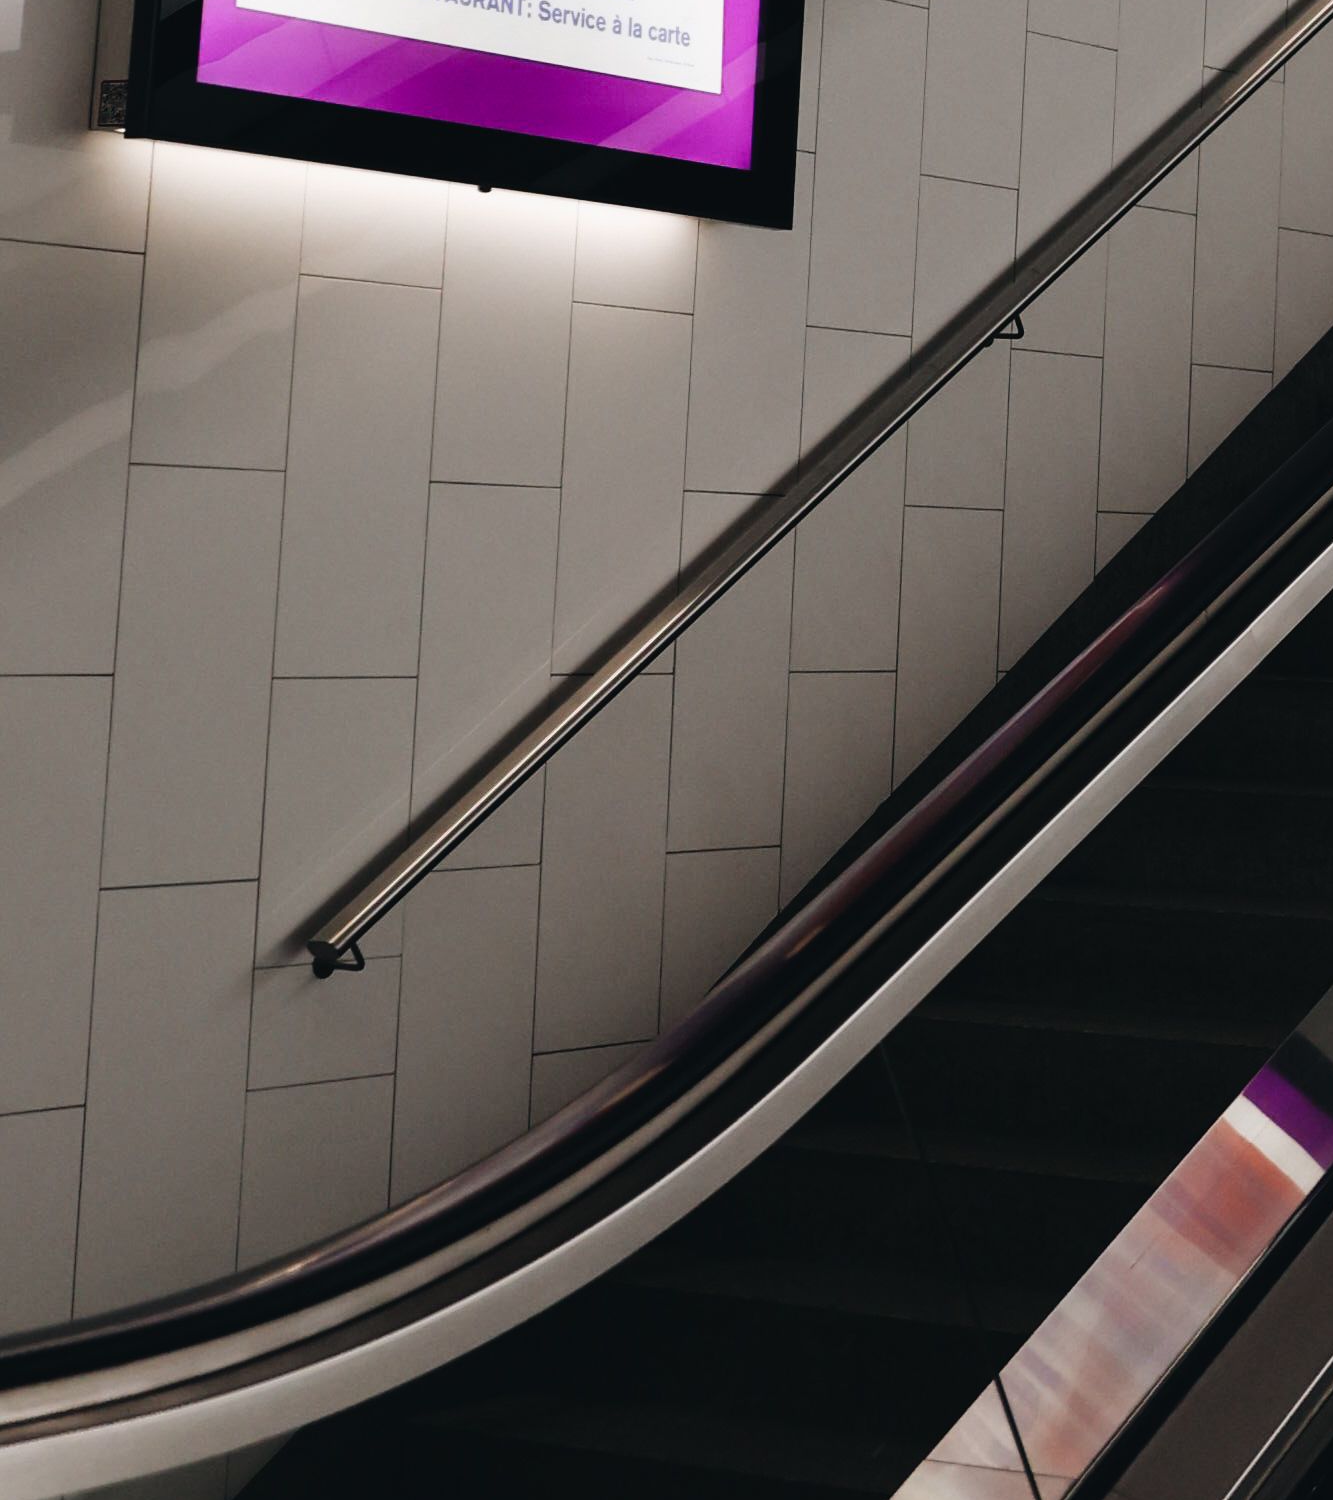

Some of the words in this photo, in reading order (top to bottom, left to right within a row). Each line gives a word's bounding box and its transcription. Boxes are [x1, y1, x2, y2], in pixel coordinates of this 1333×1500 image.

[537, 0, 606, 32] Service
[611, 14, 622, 35] à
[627, 16, 642, 39] la
[647, 25, 690, 47] carte
